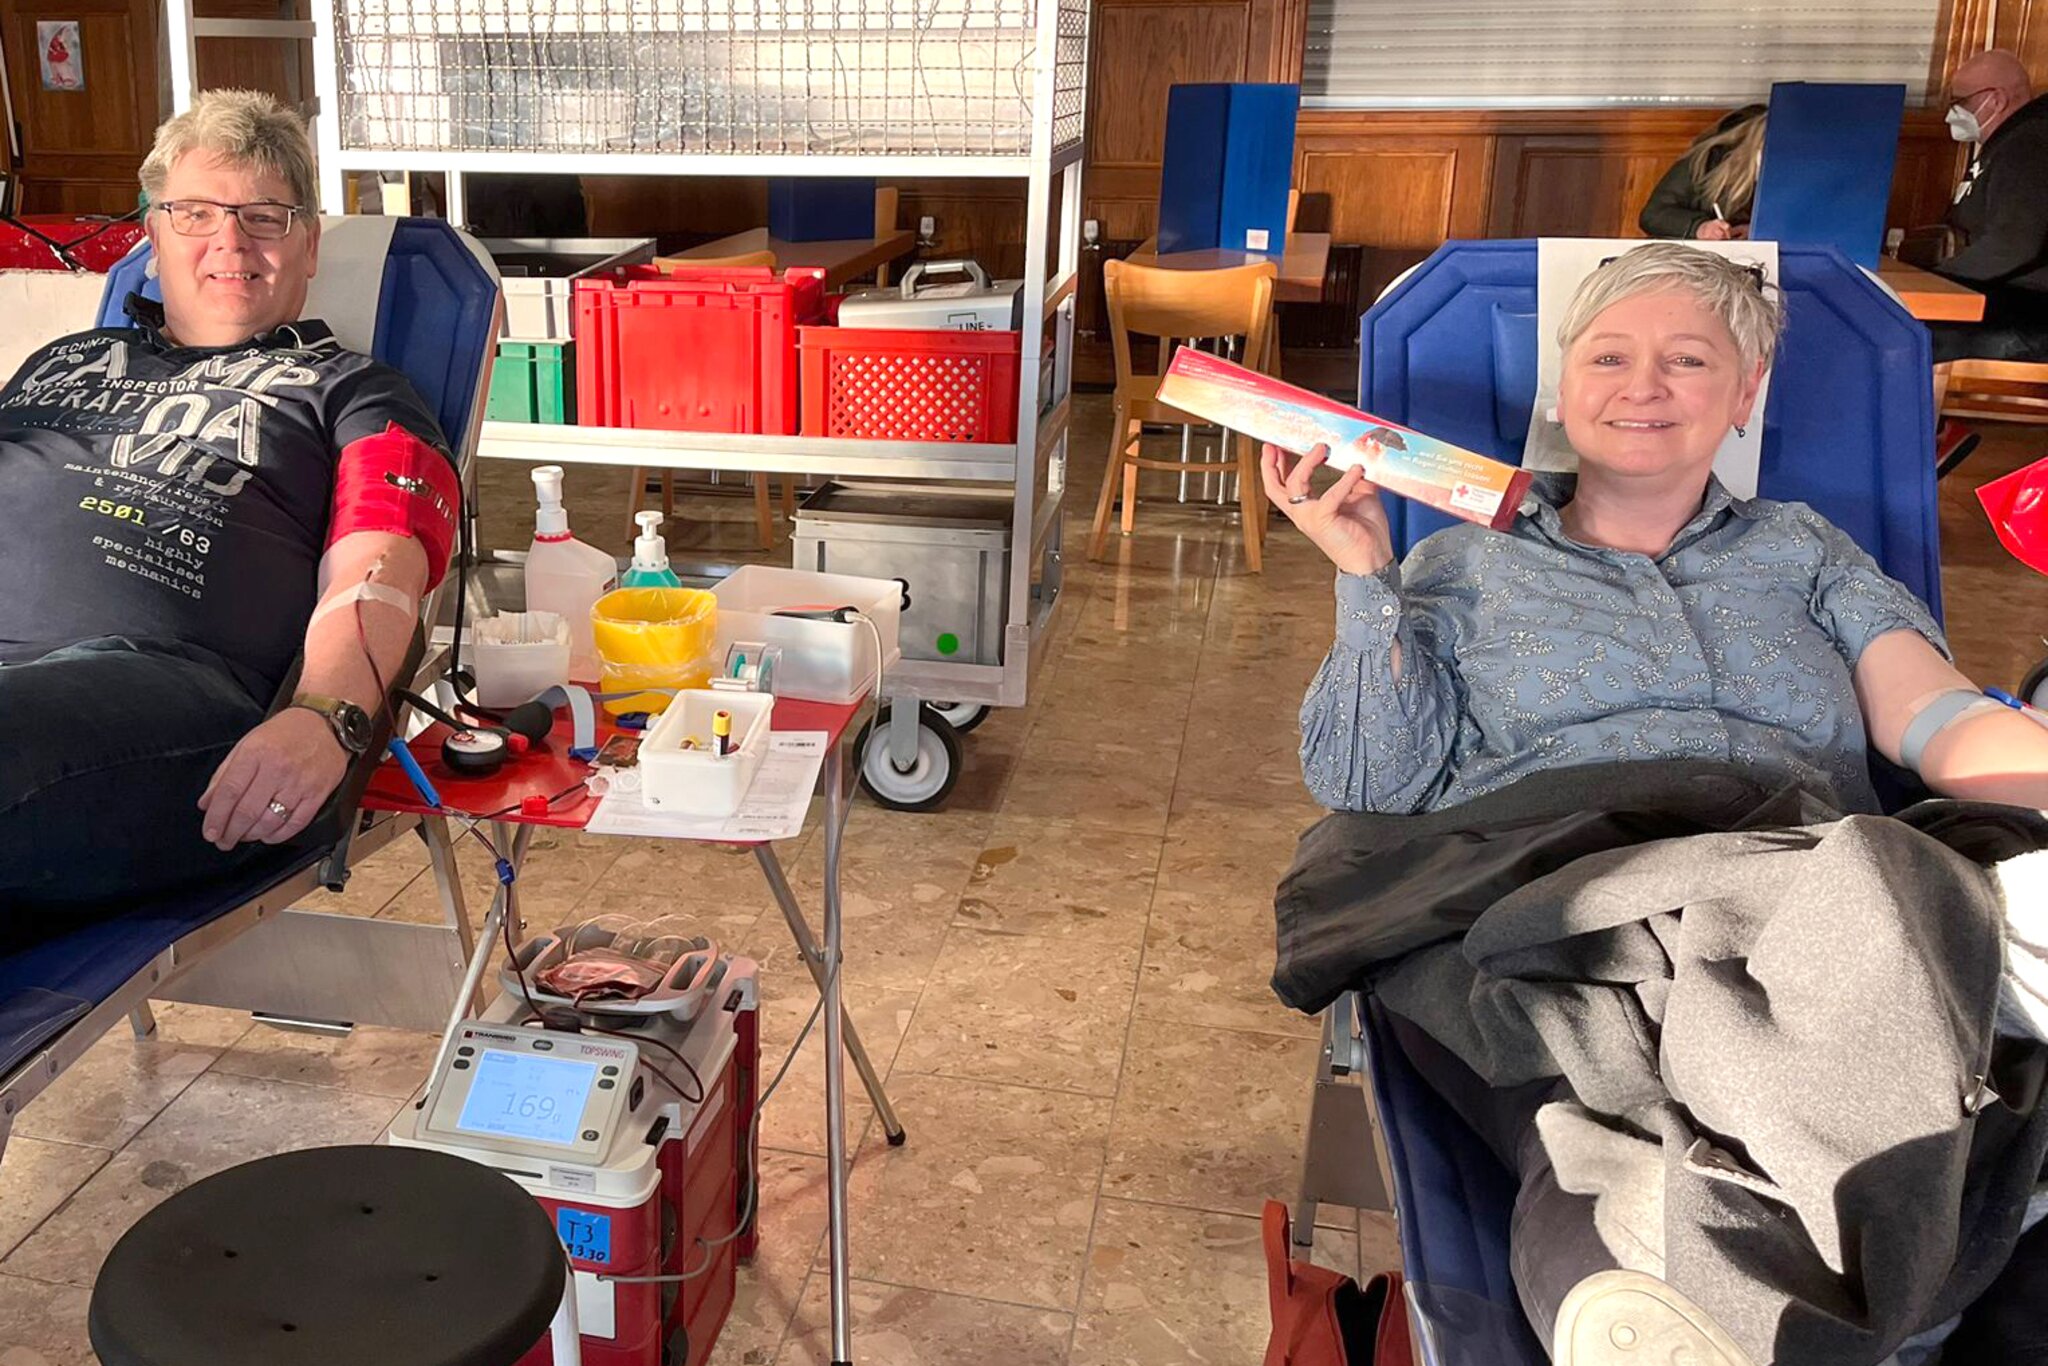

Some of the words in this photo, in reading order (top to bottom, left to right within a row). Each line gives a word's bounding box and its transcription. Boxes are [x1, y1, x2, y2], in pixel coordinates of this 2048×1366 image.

[97, 378, 198, 394] INSPECTOR
[92, 534, 206, 586] specialised
[144, 535, 205, 570] highly
[104, 554, 202, 600] mechanics
[580, 1044, 625, 1059] TOPSWING
